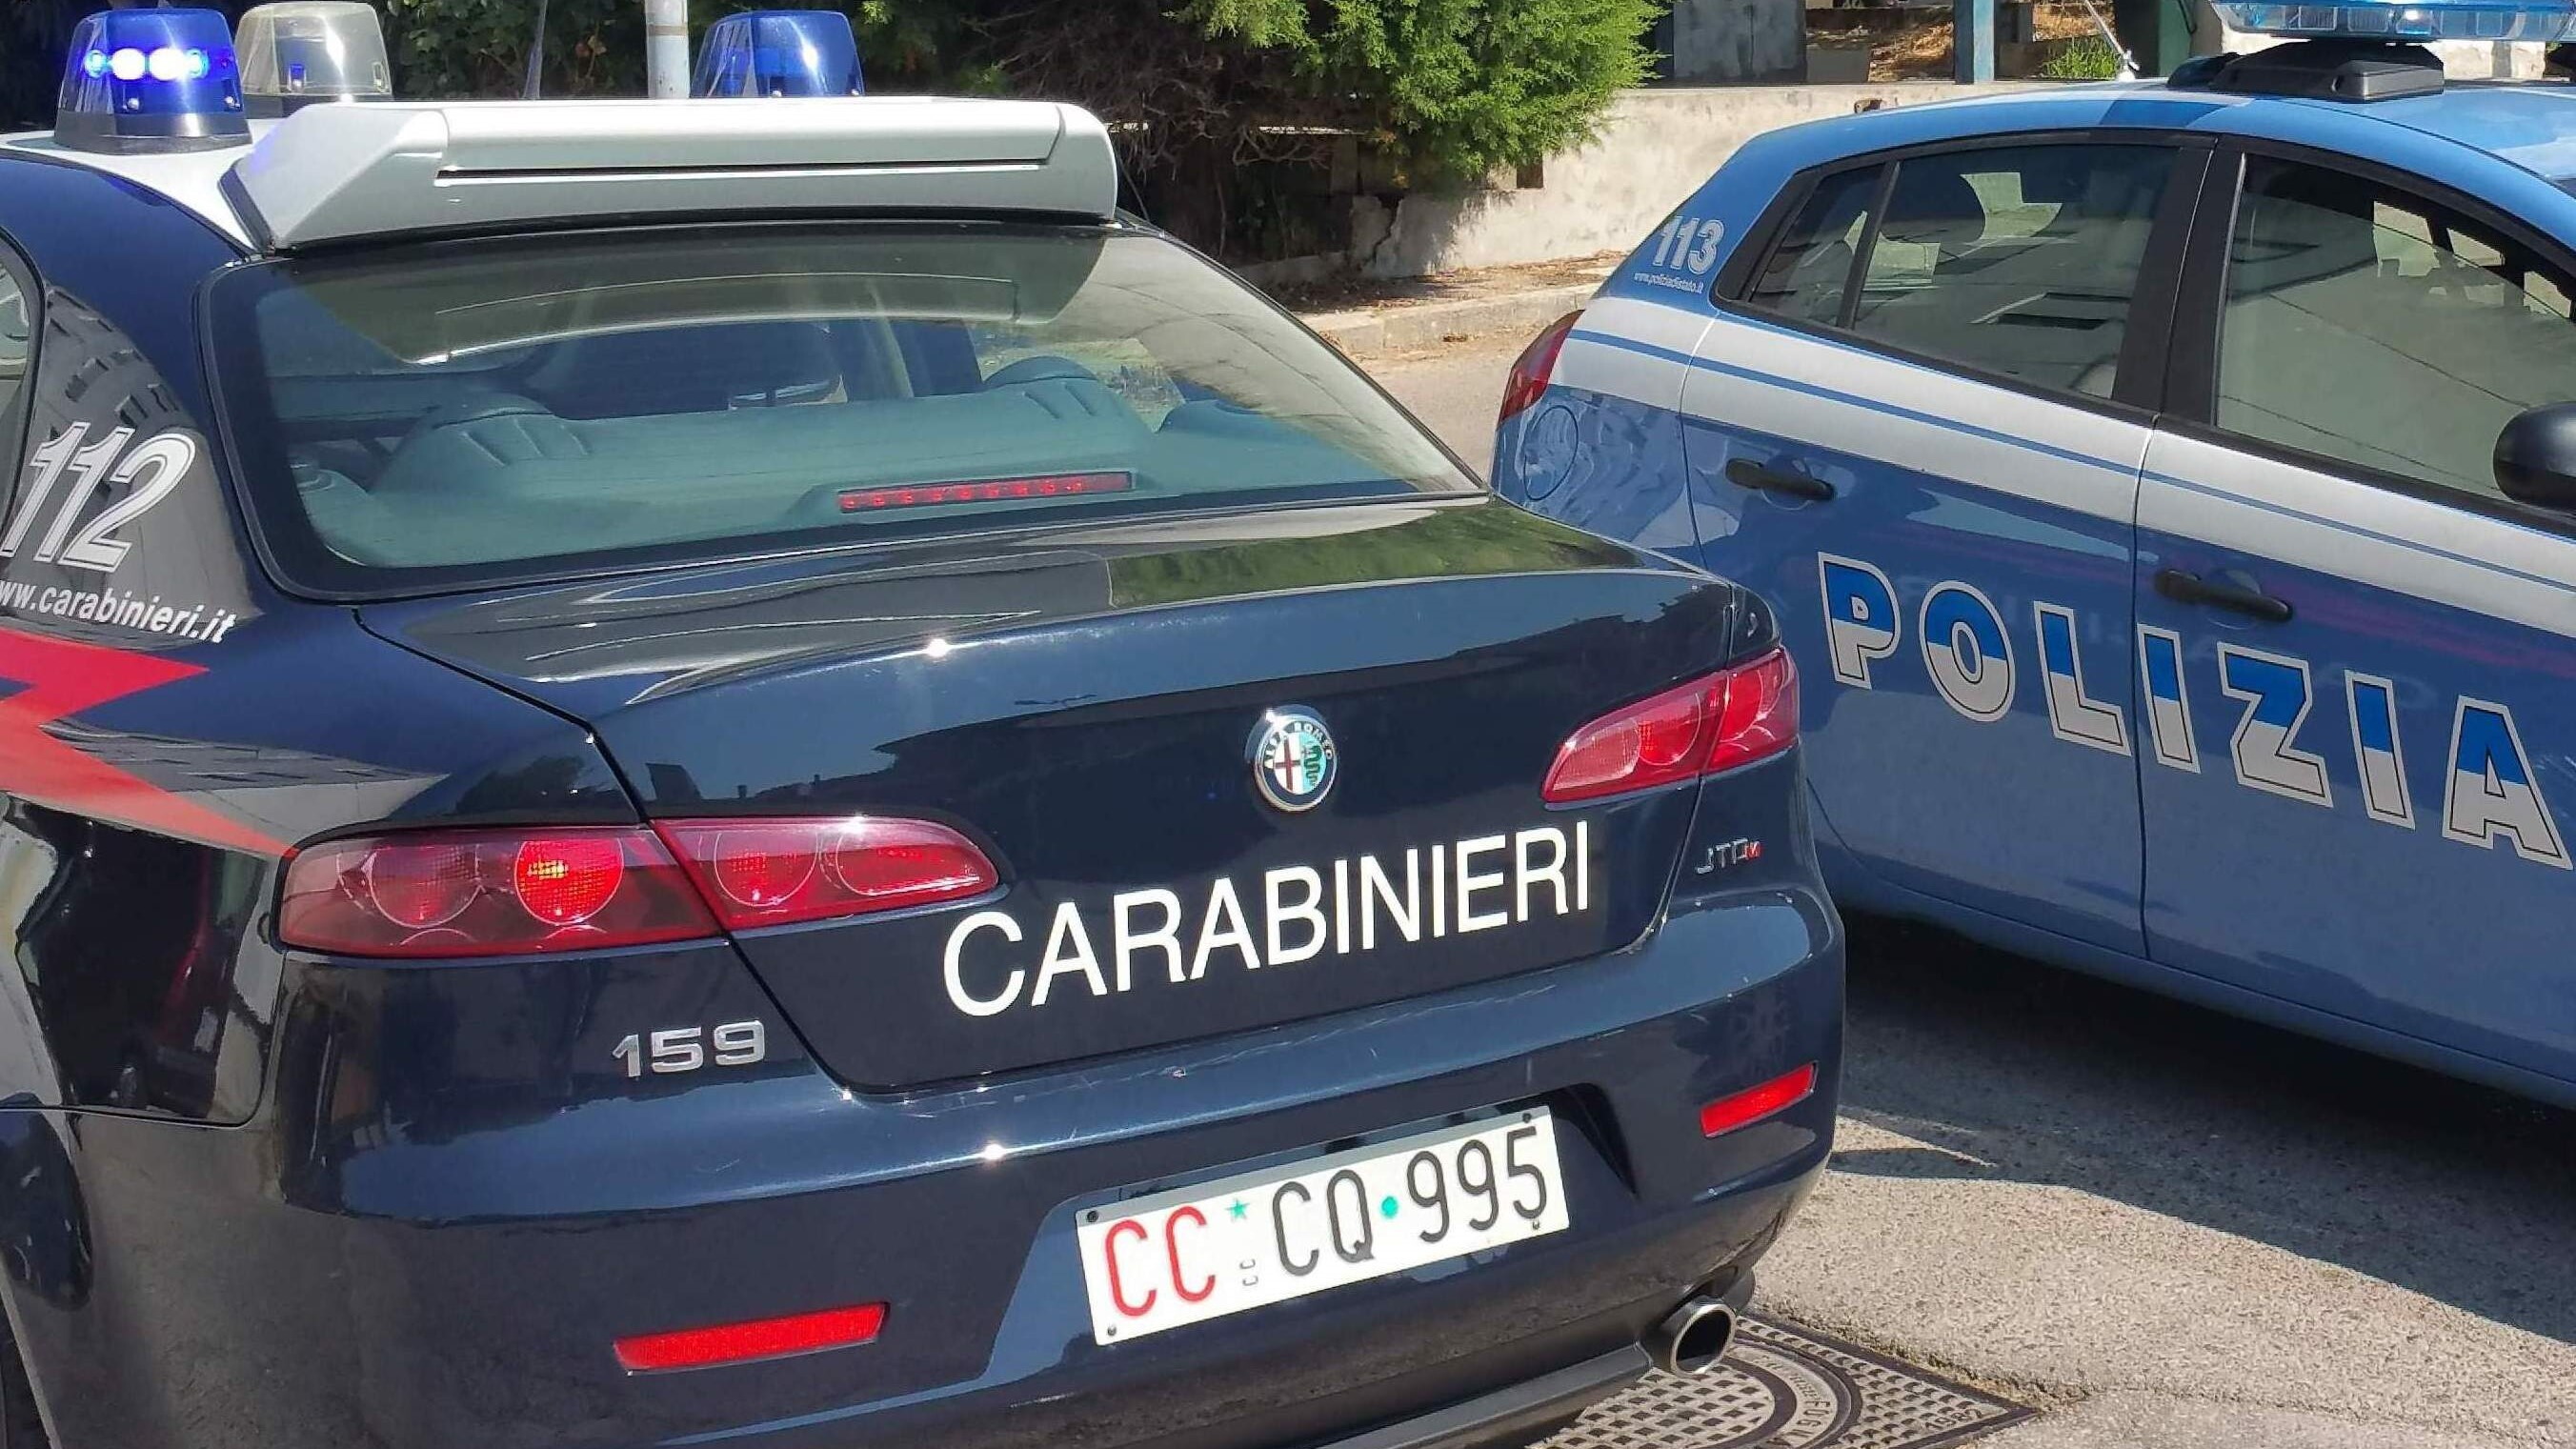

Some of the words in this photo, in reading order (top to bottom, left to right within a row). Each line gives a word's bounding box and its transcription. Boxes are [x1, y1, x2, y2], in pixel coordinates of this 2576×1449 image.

[1652, 215, 1725, 275] 113
[0, 421, 197, 574] 112
[1817, 551, 2574, 871] POLIZIA
[943, 820, 1590, 1017] CARABINIERI
[612, 1019, 766, 1077] 159
[1104, 1205, 1217, 1318] CC
[1271, 1169, 1376, 1277] CQ
[1406, 1125, 1548, 1243] 995
